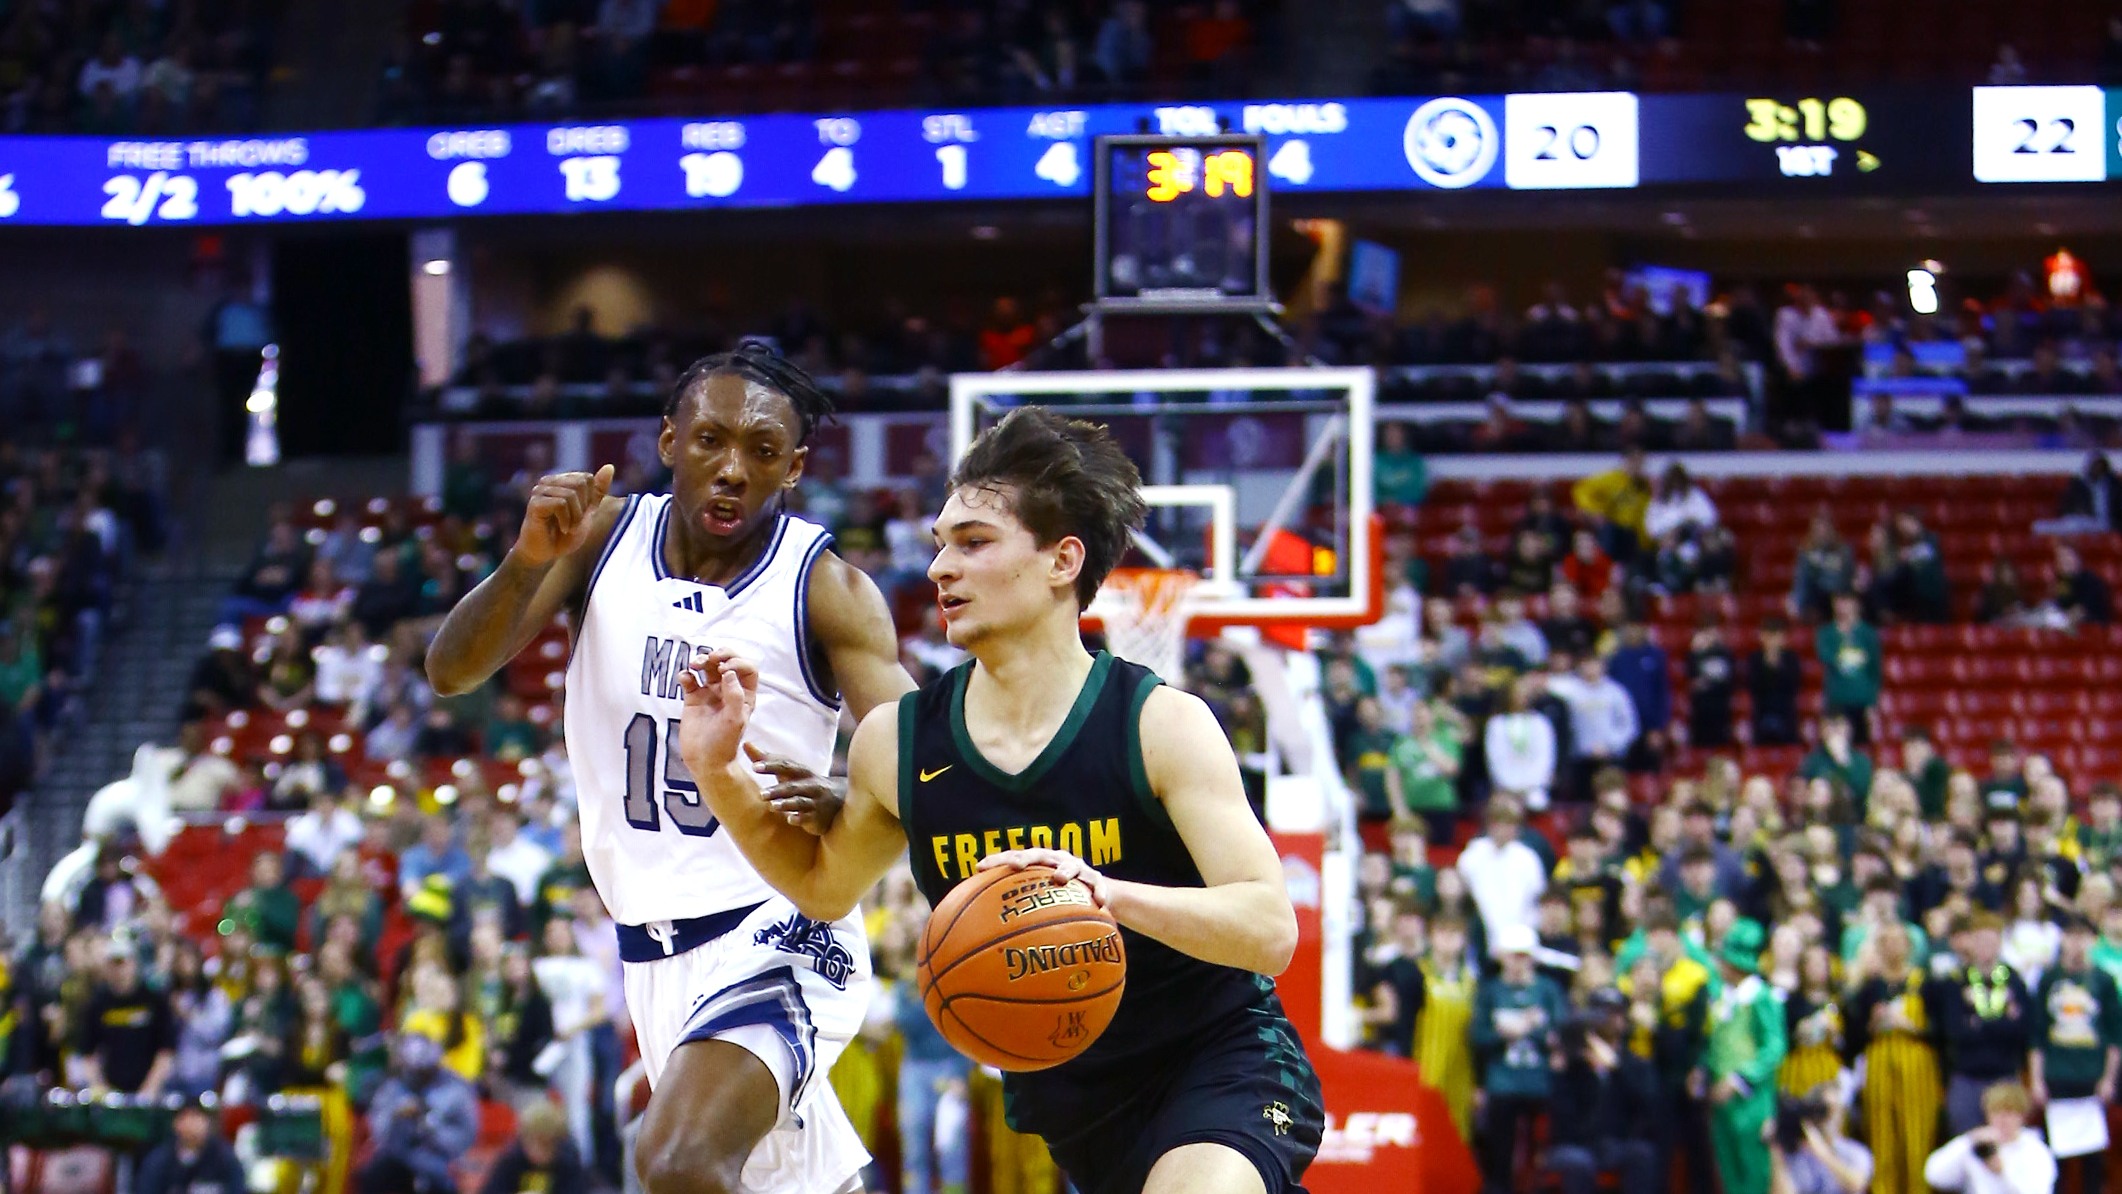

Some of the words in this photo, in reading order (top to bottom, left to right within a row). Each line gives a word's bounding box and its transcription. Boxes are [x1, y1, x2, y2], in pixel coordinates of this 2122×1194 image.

[682, 121, 746, 150] REB
[813, 117, 861, 146] TO
[922, 114, 979, 143] STL
[1027, 111, 1089, 140] AST
[1154, 106, 1221, 136] TOL
[1243, 102, 1348, 134] FOULS
[1744, 97, 1868, 142] 3:19
[2011, 117, 2076, 154] 22
[107, 141, 184, 169] FREE
[186, 137, 309, 168] THROWS
[427, 130, 512, 160] OREB
[547, 125, 630, 156] DREB
[1533, 124, 1600, 160] 20
[812, 147, 858, 192] 4
[936, 144, 967, 190] 1
[1035, 141, 1080, 187] 4
[1269, 139, 1314, 184] 4
[1775, 145, 1838, 177] 1ST
[101, 171, 198, 226] 2/2
[226, 168, 365, 217] 100%
[447, 160, 489, 207] 6
[641, 635, 714, 701] MA
[623, 712, 720, 837] 15
[1005, 932, 1121, 982] SPALDING
